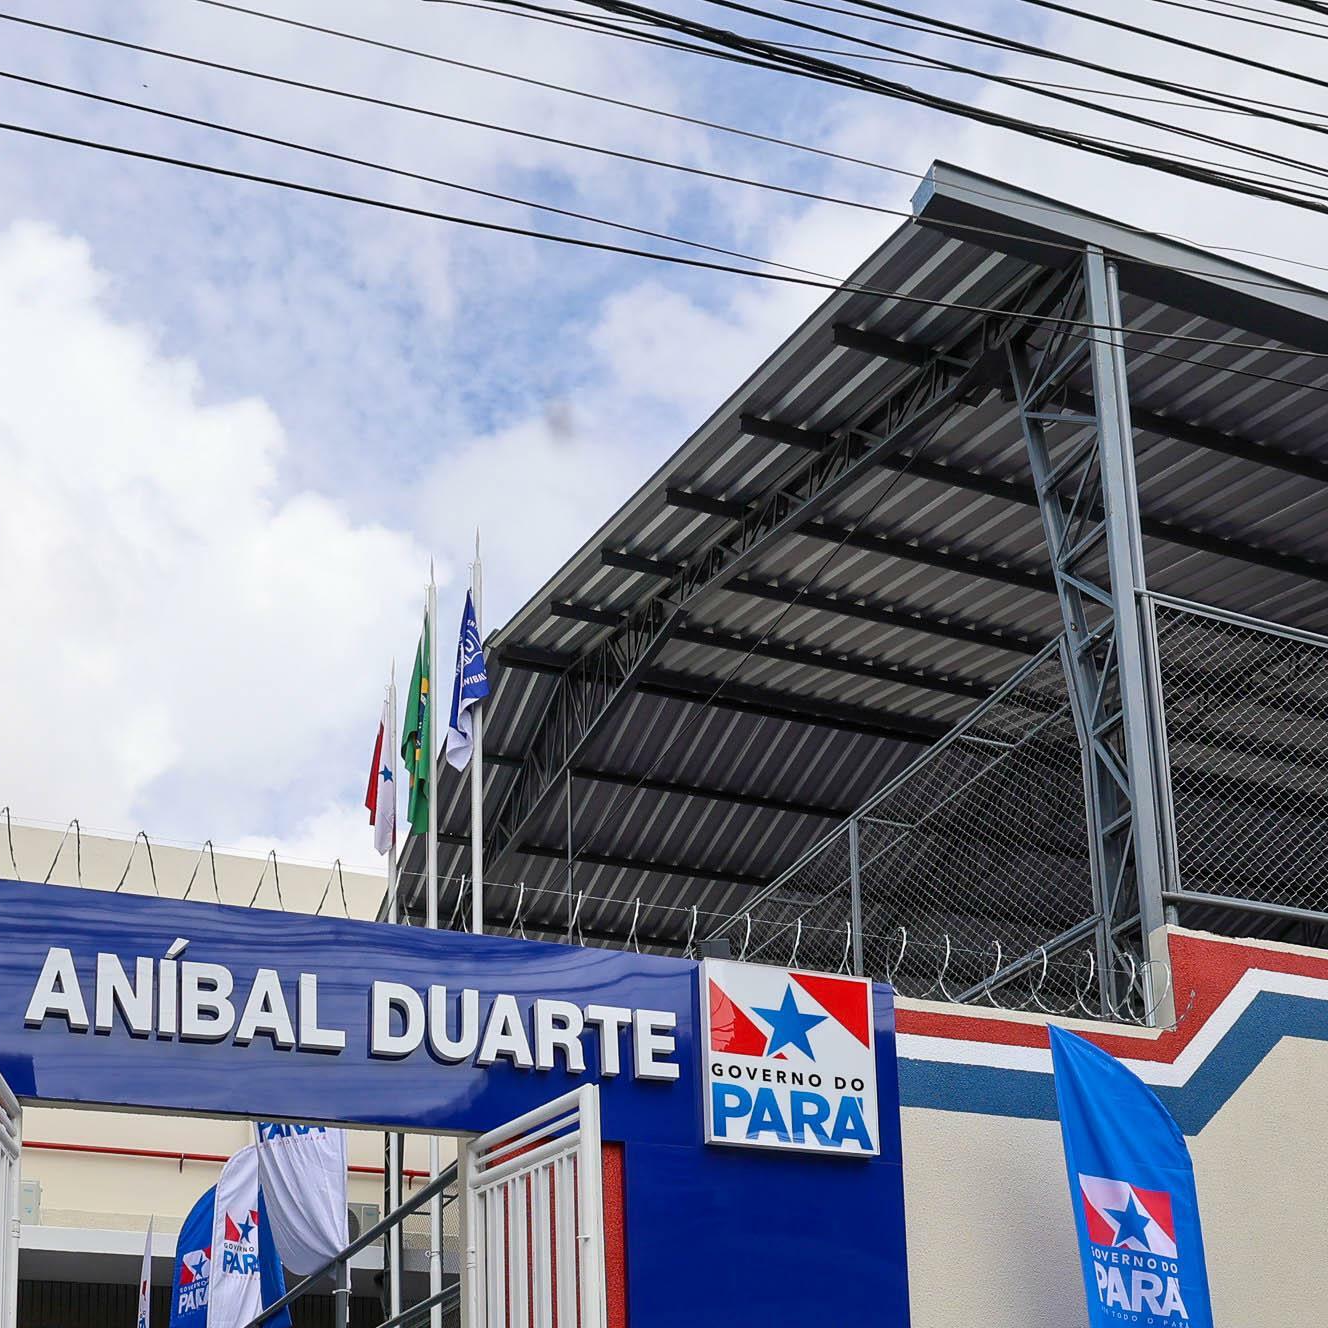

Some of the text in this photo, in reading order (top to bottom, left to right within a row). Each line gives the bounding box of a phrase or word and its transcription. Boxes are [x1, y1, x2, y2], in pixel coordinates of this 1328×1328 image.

[24, 937, 346, 1050] ANÍBAL
[371, 980, 680, 1081] DUARTE
[711, 1063, 865, 1091] GOVERNO DO
[1161, 1261, 1178, 1274] DO
